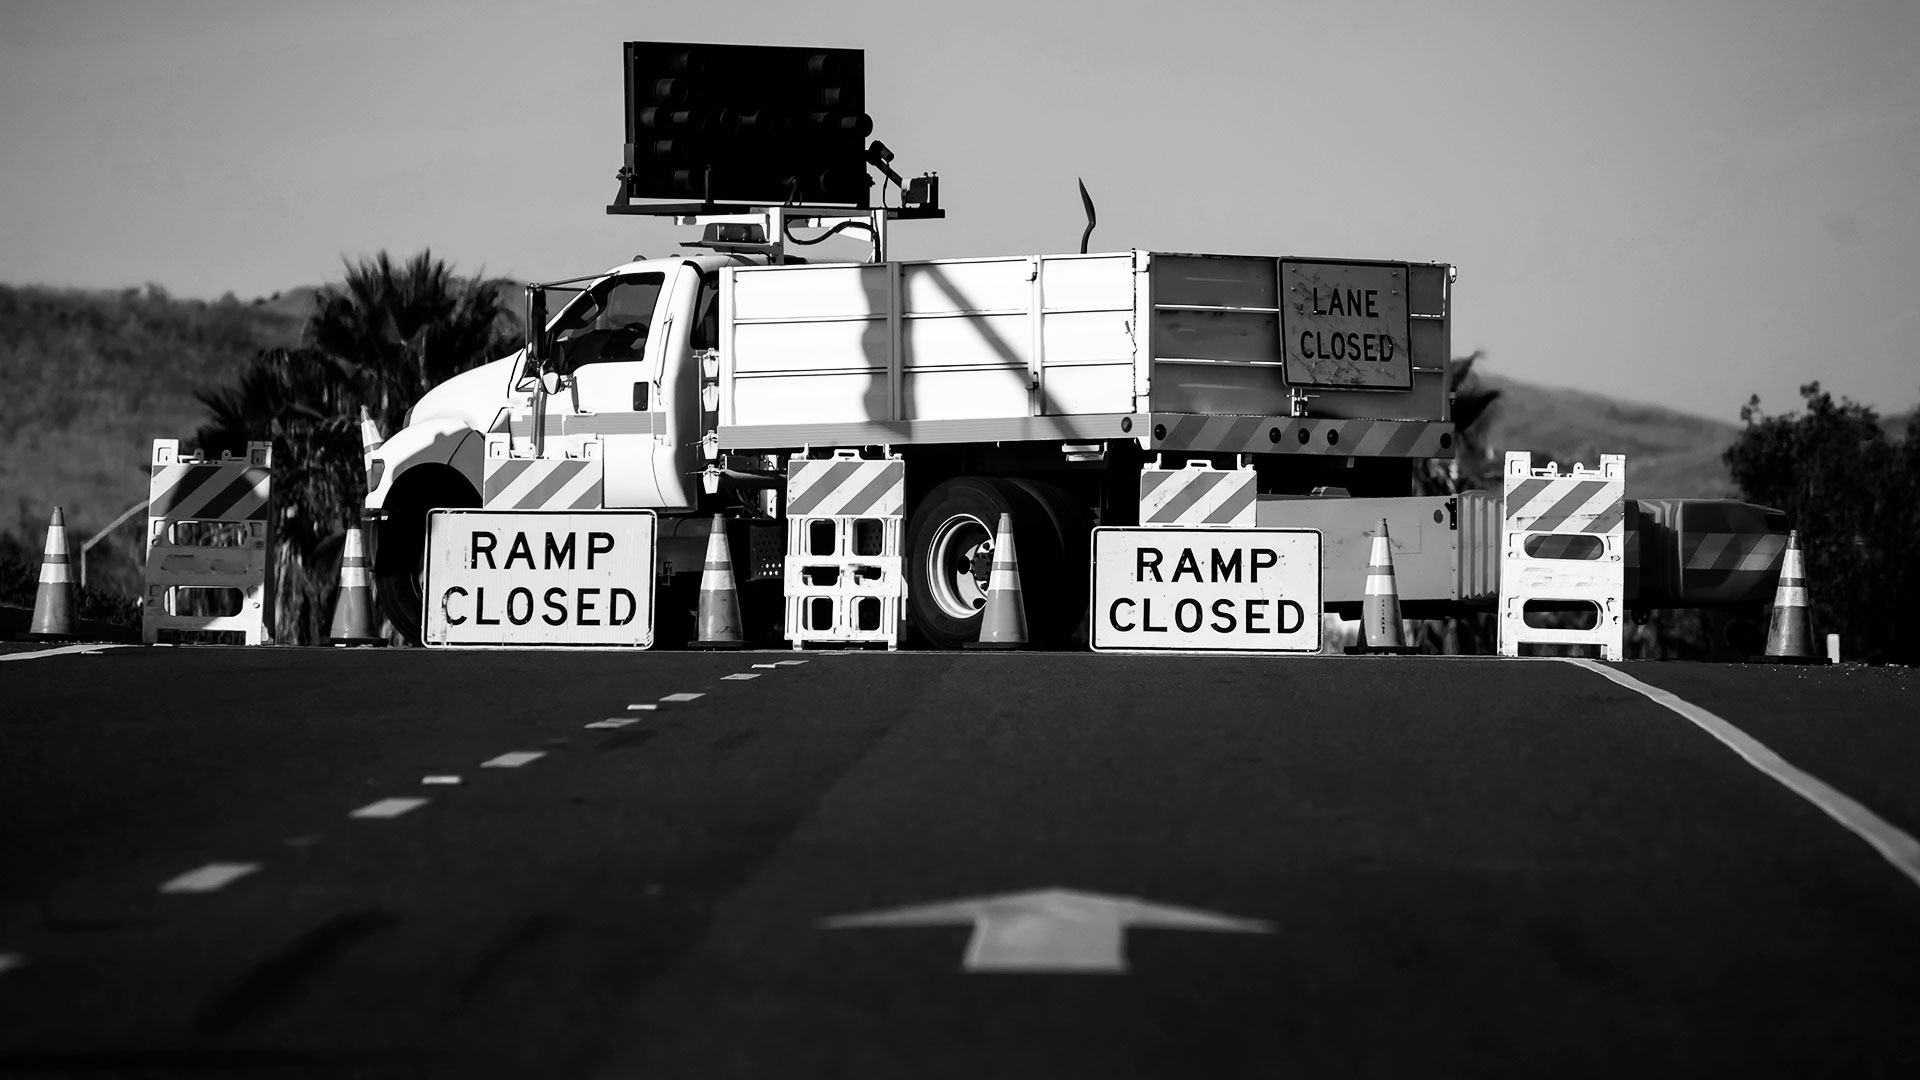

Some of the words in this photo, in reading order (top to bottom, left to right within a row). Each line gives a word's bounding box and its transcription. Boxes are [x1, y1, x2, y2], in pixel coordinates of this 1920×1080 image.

[1313, 287, 1378, 317] LANE
[1301, 330, 1393, 362] CLOSED
[470, 531, 615, 569] RAMP
[1137, 548, 1277, 582] RAMP
[443, 586, 636, 626] CLOSED
[1110, 598, 1304, 633] CLOSED
